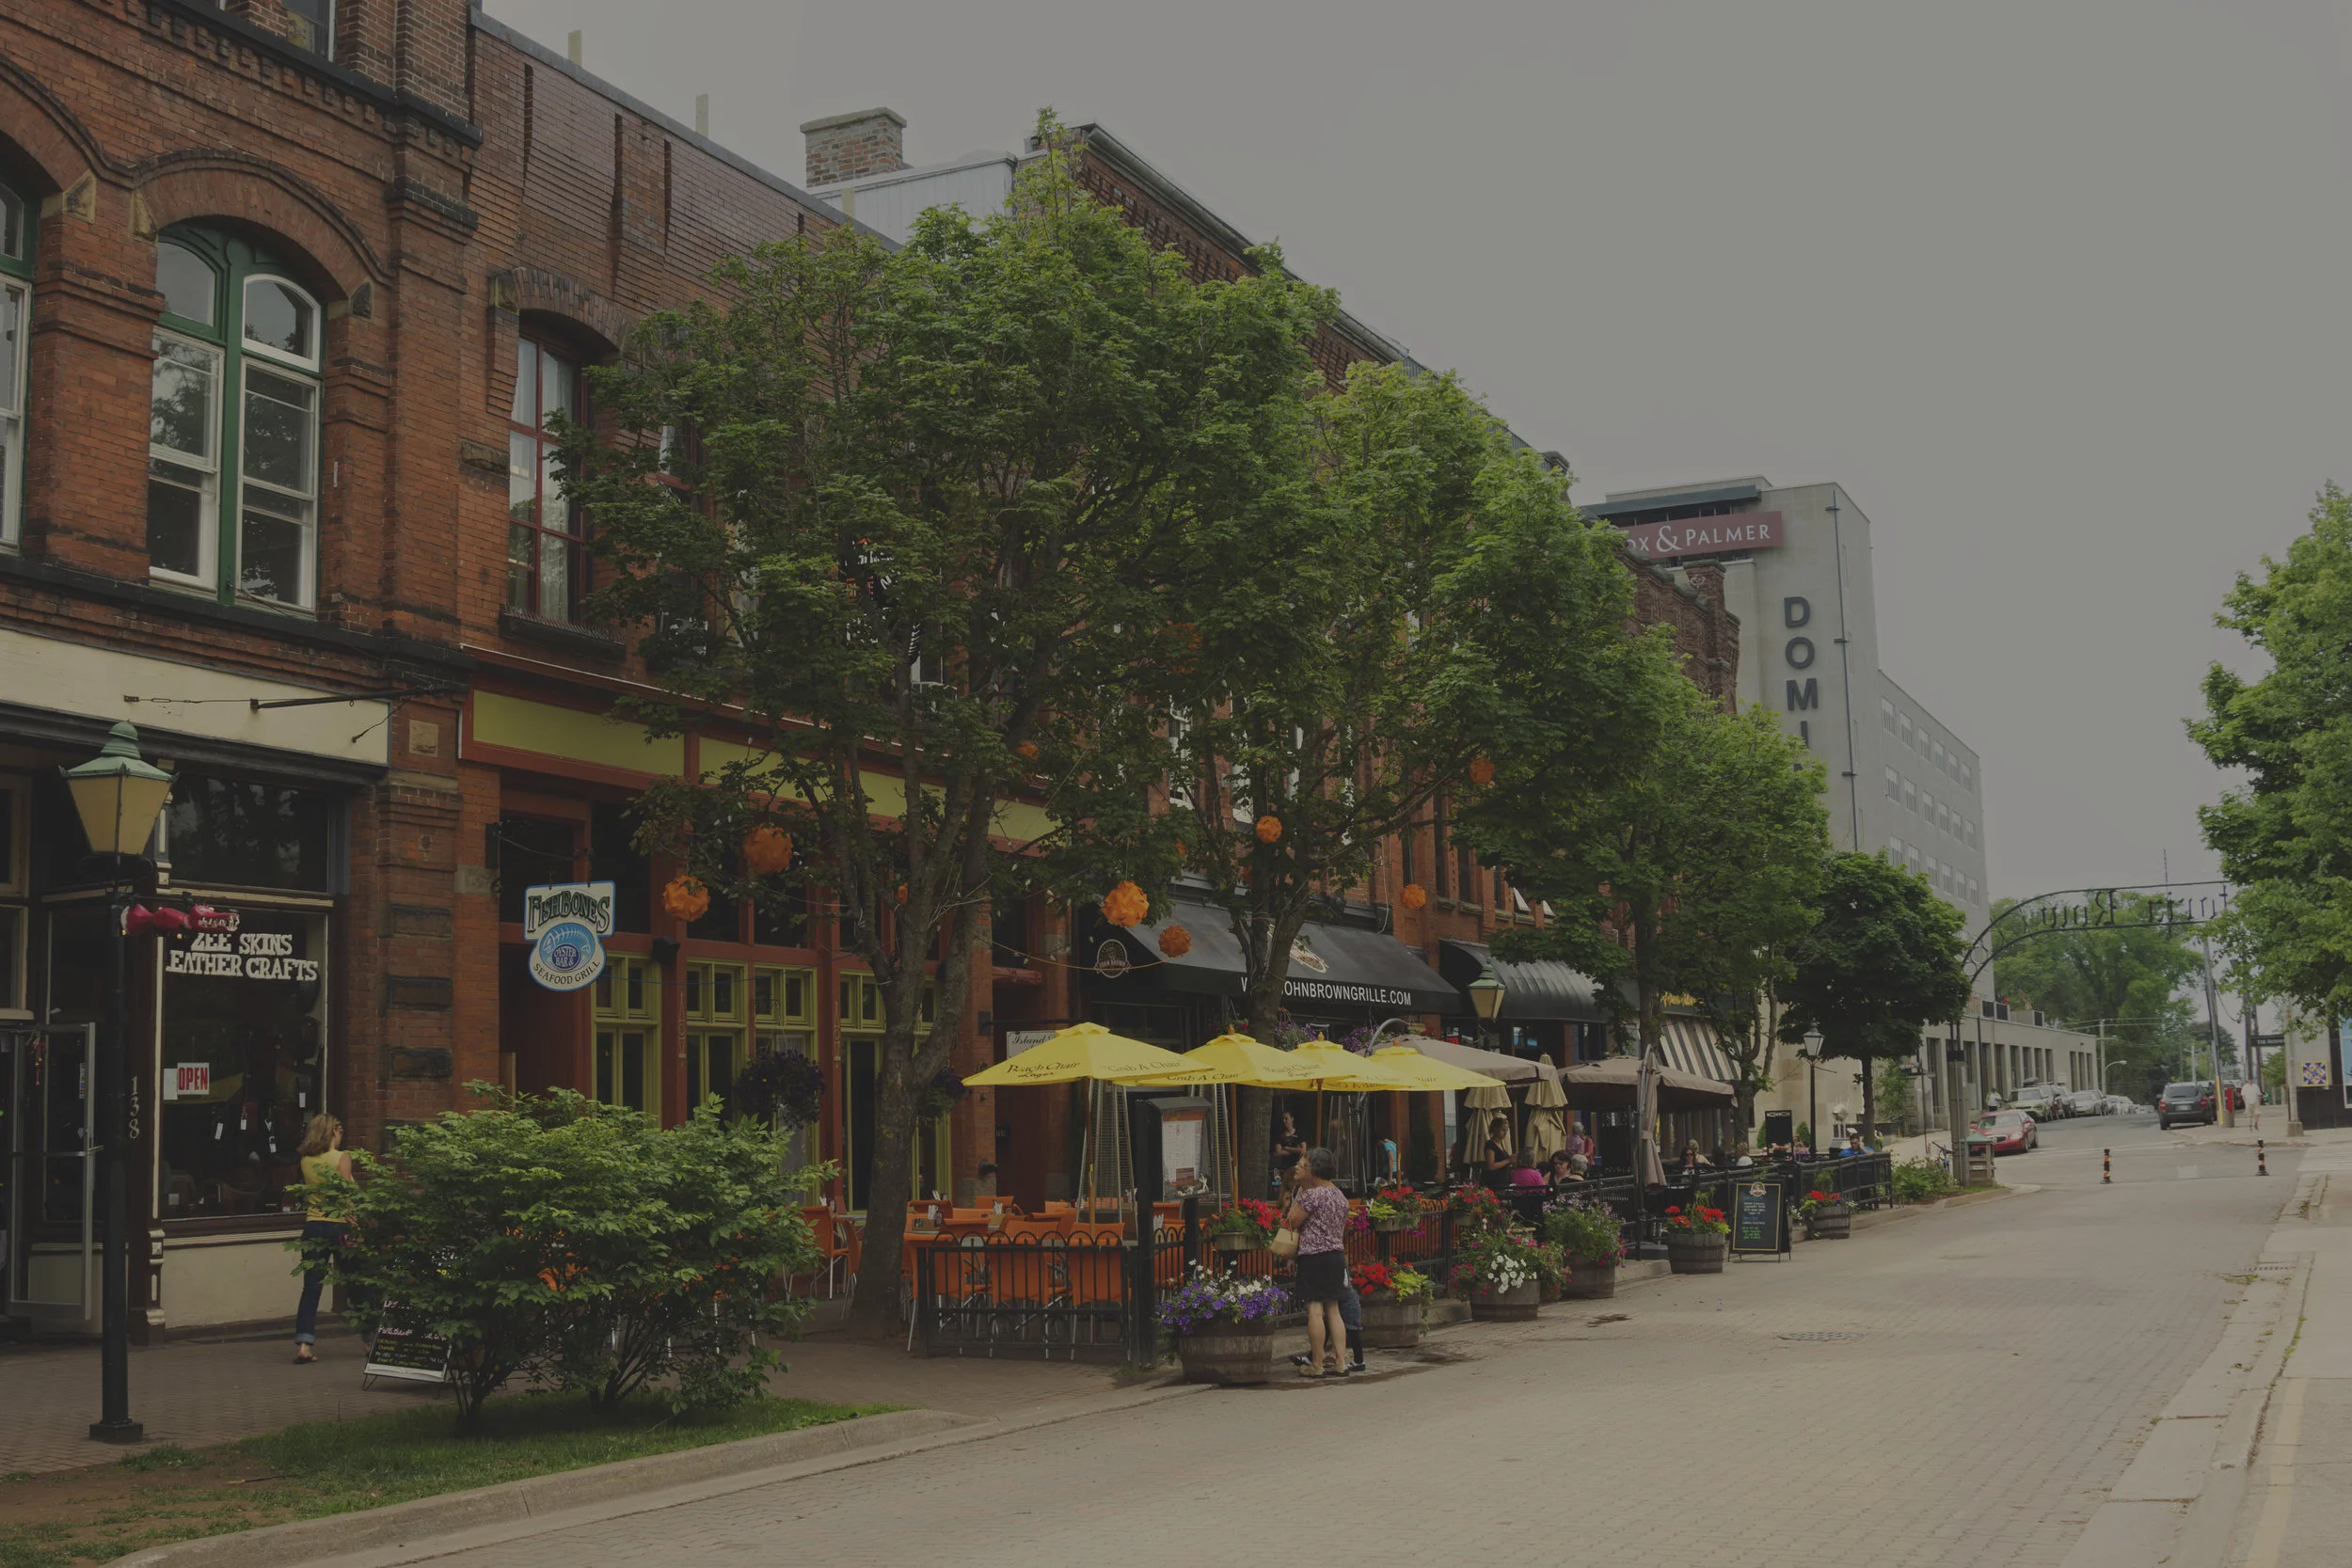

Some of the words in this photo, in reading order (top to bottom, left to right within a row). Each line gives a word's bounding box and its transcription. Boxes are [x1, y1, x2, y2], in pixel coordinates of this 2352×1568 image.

[1656, 525, 1684, 553] &
[1685, 524, 1771, 546] PALMER
[1784, 596, 1819, 752] DOMI
[239, 932, 293, 956] SKINS
[554, 946, 577, 958] OYSTER
[166, 949, 243, 977] EATHER
[246, 957, 319, 981] CRAFTS
[533, 963, 573, 985] SEAFOOD
[575, 960, 600, 983] GRILL
[555, 957, 568, 967] BAR
[1281, 980, 1411, 1006] OHNBROWNGRILLE.COM
[1011, 1035, 1047, 1044] Island
[178, 1067, 208, 1090] OPEN
[129, 1075, 140, 1139] 138
